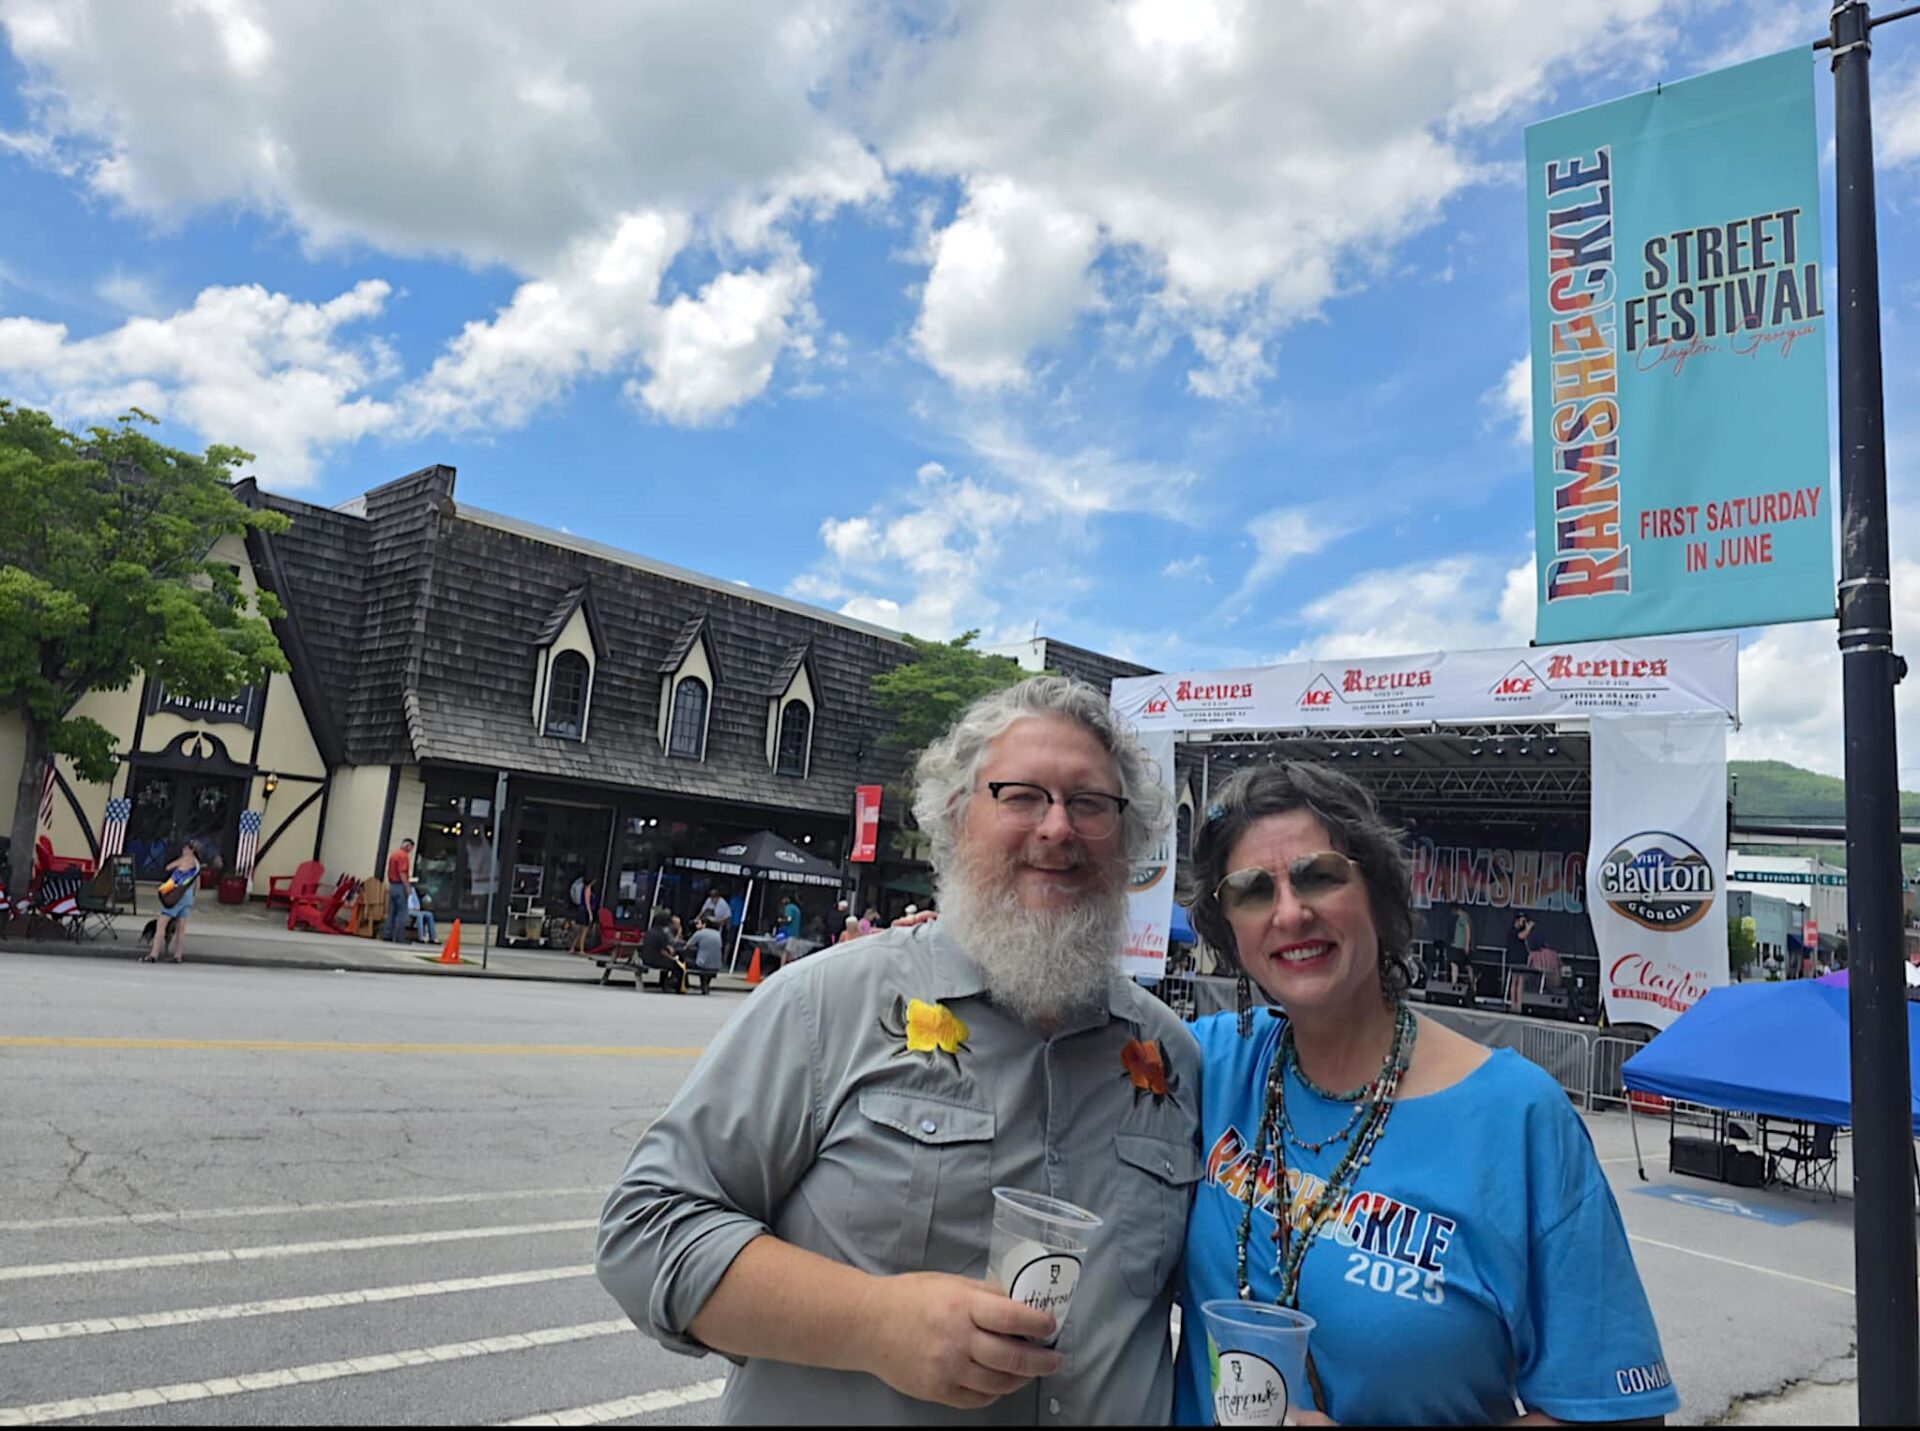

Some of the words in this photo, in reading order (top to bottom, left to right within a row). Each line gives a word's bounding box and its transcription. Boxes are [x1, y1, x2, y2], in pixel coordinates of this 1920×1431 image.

[1644, 208, 1802, 291] STREET
[1624, 263, 1826, 353] FESTIVAL
[1545, 144, 1632, 604] RAMSHACKLE
[1639, 504, 1699, 541] FIRST
[1705, 486, 1823, 534] SATURDAY
[1685, 543, 1708, 574] IN
[1713, 533, 1774, 569] JUNE
[1548, 654, 1668, 679] Reeves
[1176, 680, 1255, 702] Reeves
[1342, 668, 1433, 693] Reeves
[1496, 678, 1535, 694] ACE
[1143, 700, 1169, 714] ACE
[1301, 690, 1332, 705] ACE
[1636, 854, 1664, 864] VISIT
[1597, 861, 1712, 902] Clayton
[1629, 902, 1691, 920] GEORGIA
[1343, 1253, 1446, 1306] 2025
